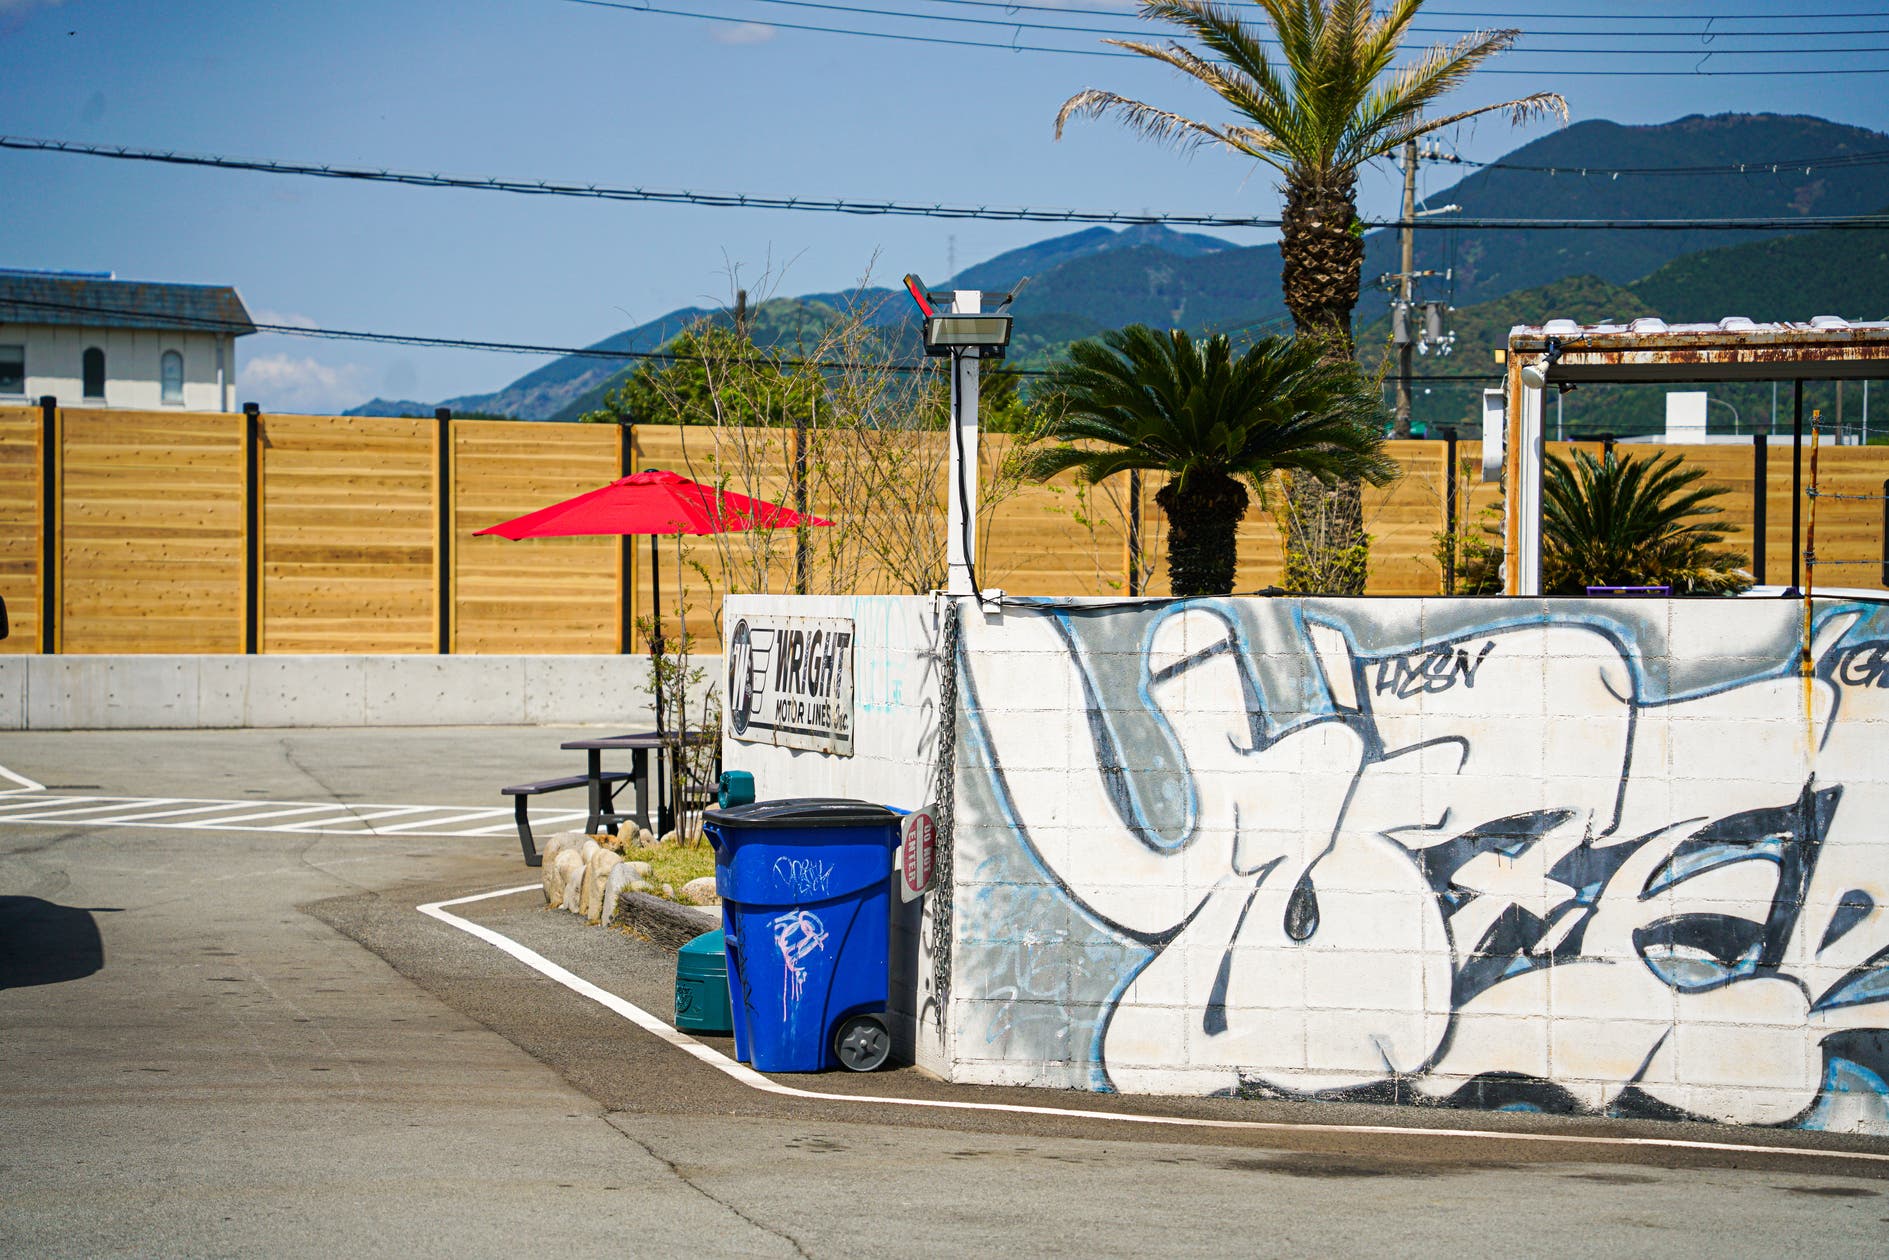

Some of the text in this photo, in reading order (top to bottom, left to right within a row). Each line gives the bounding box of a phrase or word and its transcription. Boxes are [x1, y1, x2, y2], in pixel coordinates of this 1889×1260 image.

[775, 628, 850, 699] WRIGHT
[775, 699, 804, 724] MOTOR
[807, 703, 831, 728] LINES
[908, 831, 917, 882] ENTER
[923, 823, 932, 873] DO NOT
